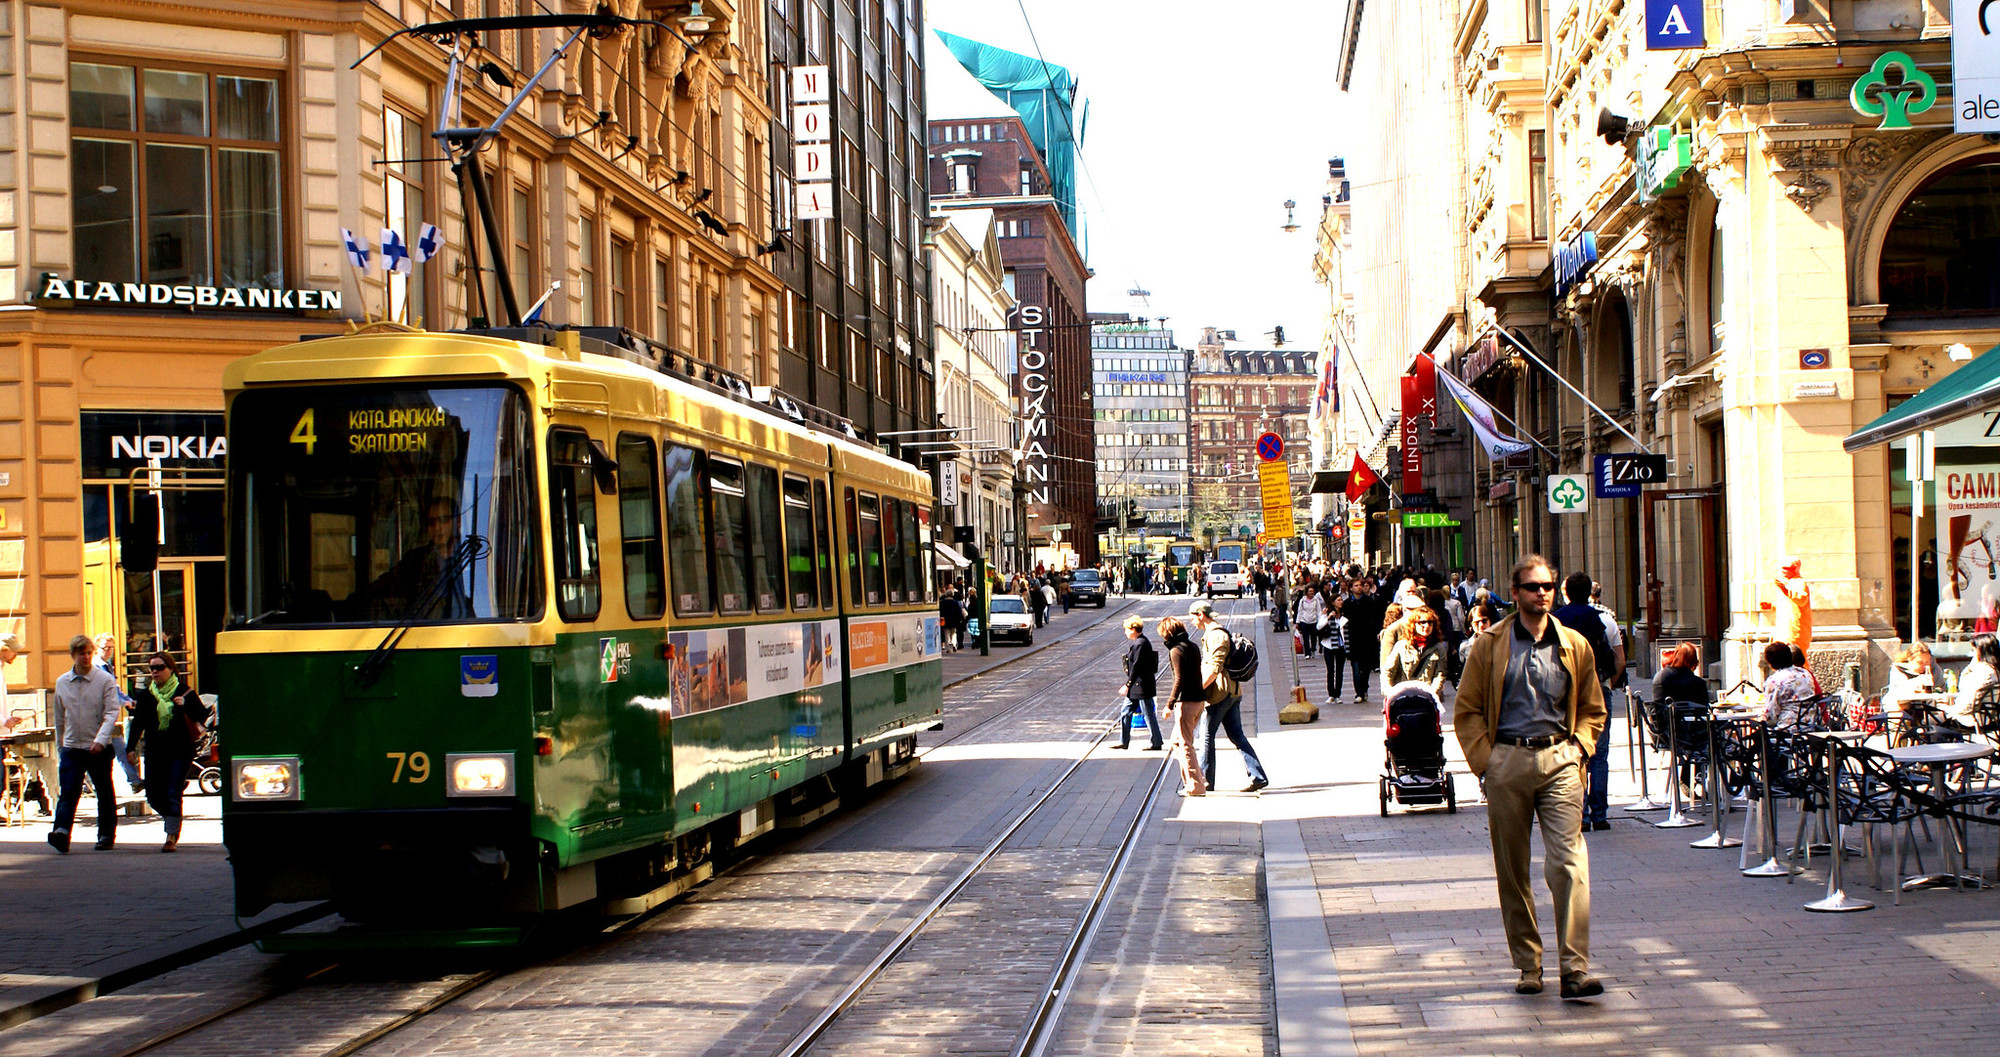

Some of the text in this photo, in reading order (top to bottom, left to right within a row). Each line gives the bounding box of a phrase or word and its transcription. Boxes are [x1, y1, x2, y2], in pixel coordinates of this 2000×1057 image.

[1659, 4, 1691, 35] A
[804, 73, 820, 212] MODA
[43, 272, 342, 310] ÅLANDSBANKEN
[1021, 306, 1049, 505] STOCKMANN
[290, 407, 317, 455] 4
[350, 408, 445, 430] KATAJANOKKA
[111, 435, 227, 459] NOKIA
[349, 432, 427, 453] SKATUDDEN
[1407, 415, 1419, 472] LINDEX
[1615, 459, 1653, 480] Zio
[1947, 472, 2000, 500] CAM
[1144, 511, 1174, 523] Aktia
[1409, 514, 1460, 526] ELIX
[617, 642, 631, 658] HKL
[617, 659, 631, 675] HST
[386, 751, 430, 783] 79
